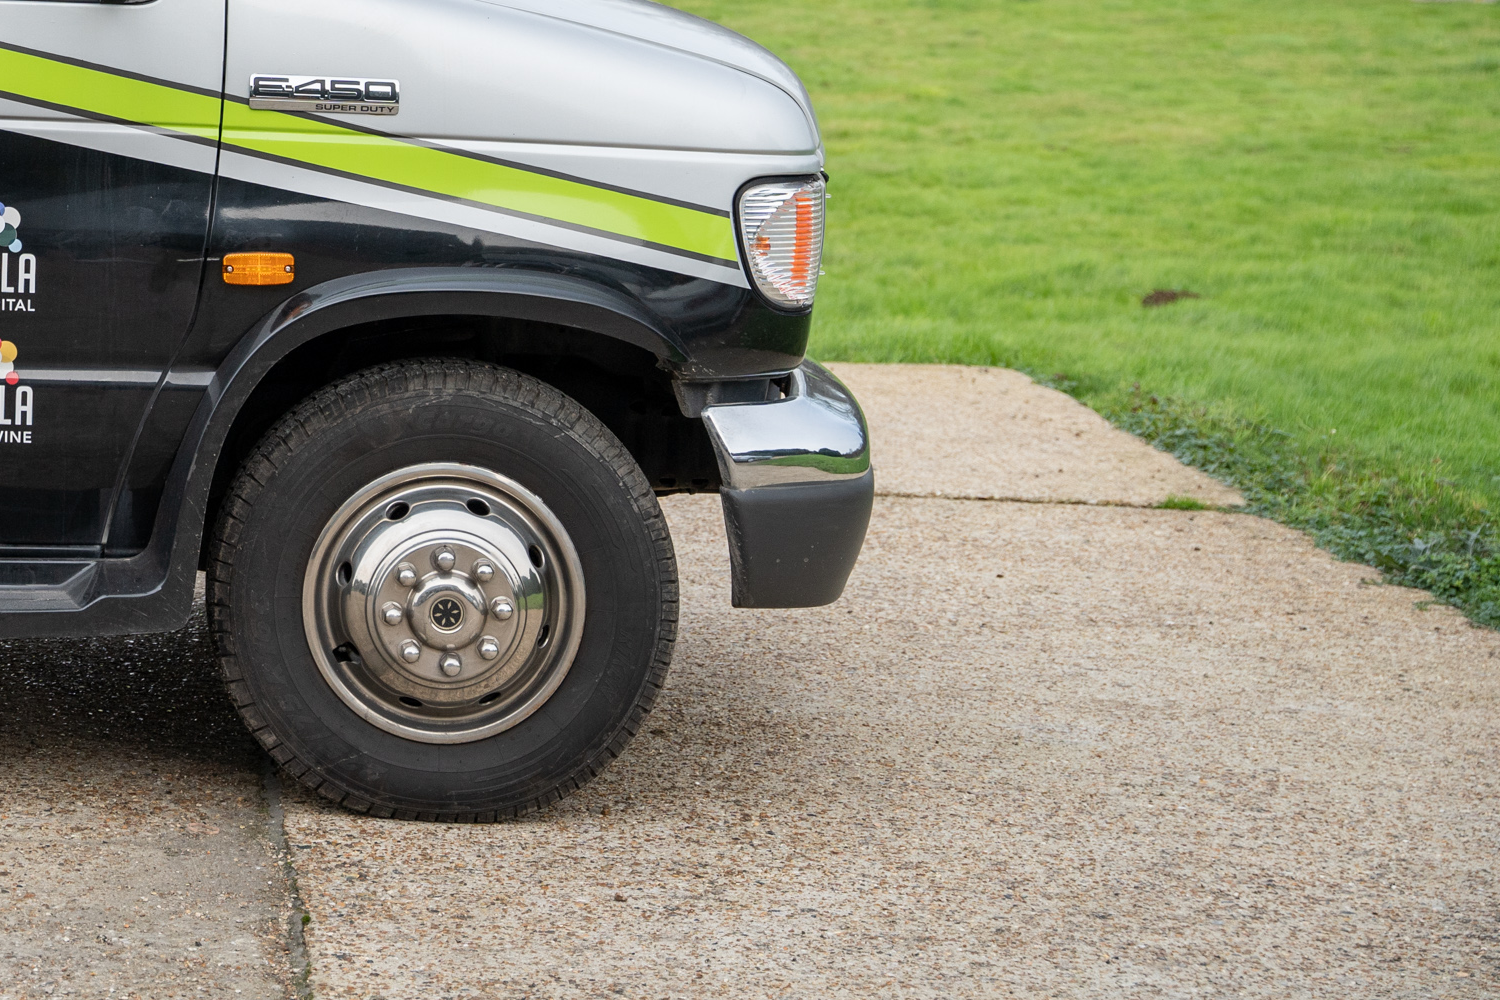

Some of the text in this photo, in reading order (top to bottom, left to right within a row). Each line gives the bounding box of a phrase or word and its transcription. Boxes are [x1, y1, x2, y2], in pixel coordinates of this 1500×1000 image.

[253, 76, 397, 102] E-450
[315, 103, 395, 113] SUPER DUTY
